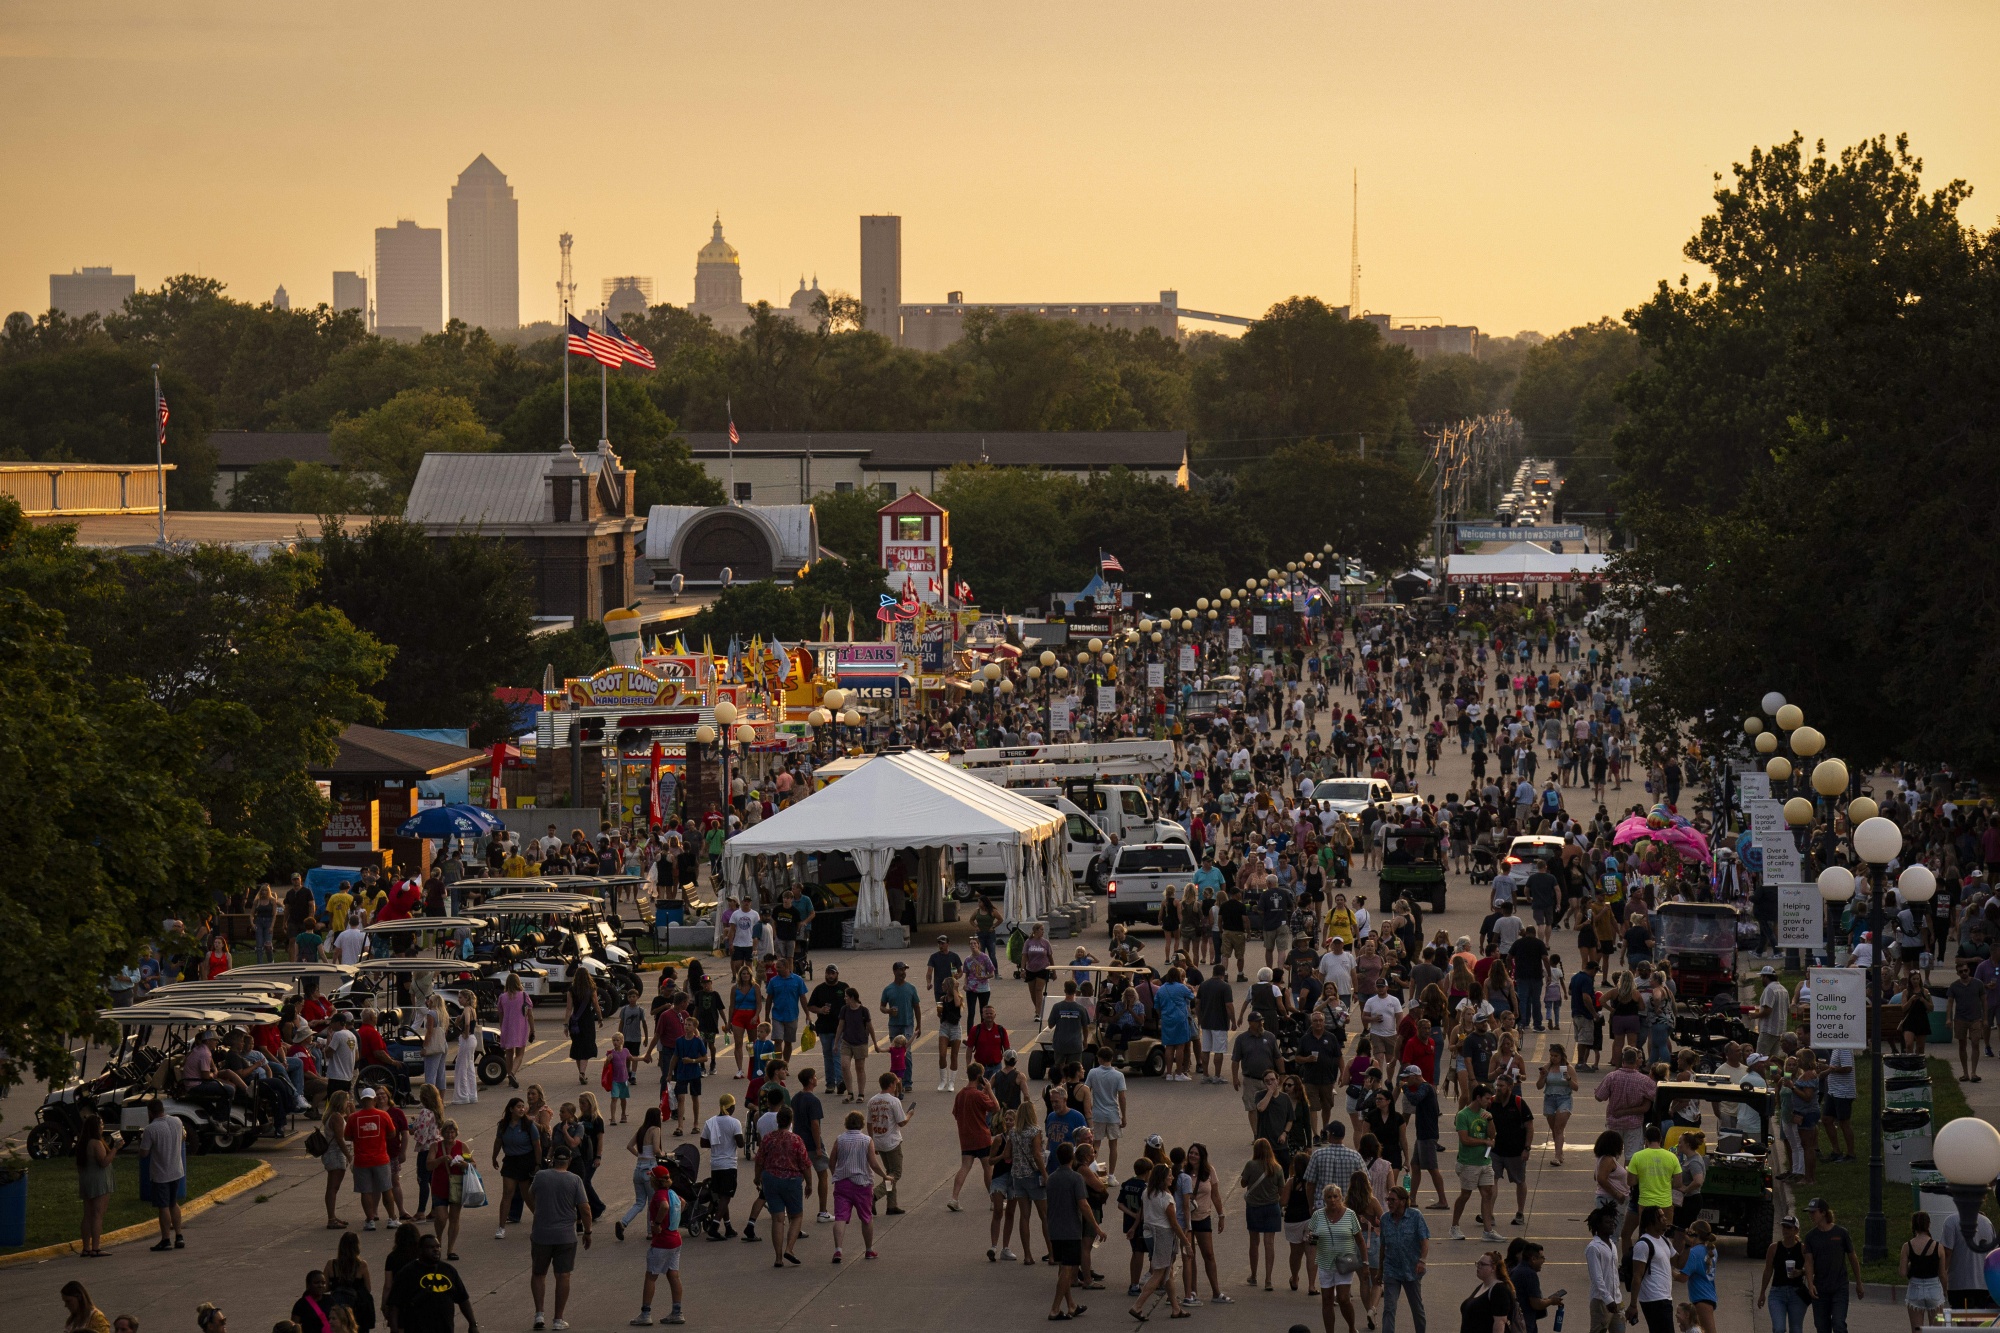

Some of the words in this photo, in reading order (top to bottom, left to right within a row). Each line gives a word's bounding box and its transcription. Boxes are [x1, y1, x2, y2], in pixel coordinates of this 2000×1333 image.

[1460, 529, 1496, 539] Welcome
[1498, 530, 1506, 539] to
[1509, 530, 1522, 539] the
[897, 548, 926, 561] COLD
[1451, 575, 1478, 583] GATE
[1481, 575, 1492, 583] 11
[855, 649, 895, 661] EARS
[591, 673, 624, 694] FOOT
[628, 672, 659, 694] LONG
[594, 696, 620, 705] HAND
[332, 814, 362, 823] REST.
[328, 822, 366, 830] RELAX.
[325, 829, 368, 837] REPEAT.
[1783, 902, 1810, 911] Helping
[1816, 977, 1839, 985] Google
[1816, 993, 1847, 1004] Calling
[1816, 1003, 1838, 1011] Iowa
[1816, 1031, 1850, 1039] decade
